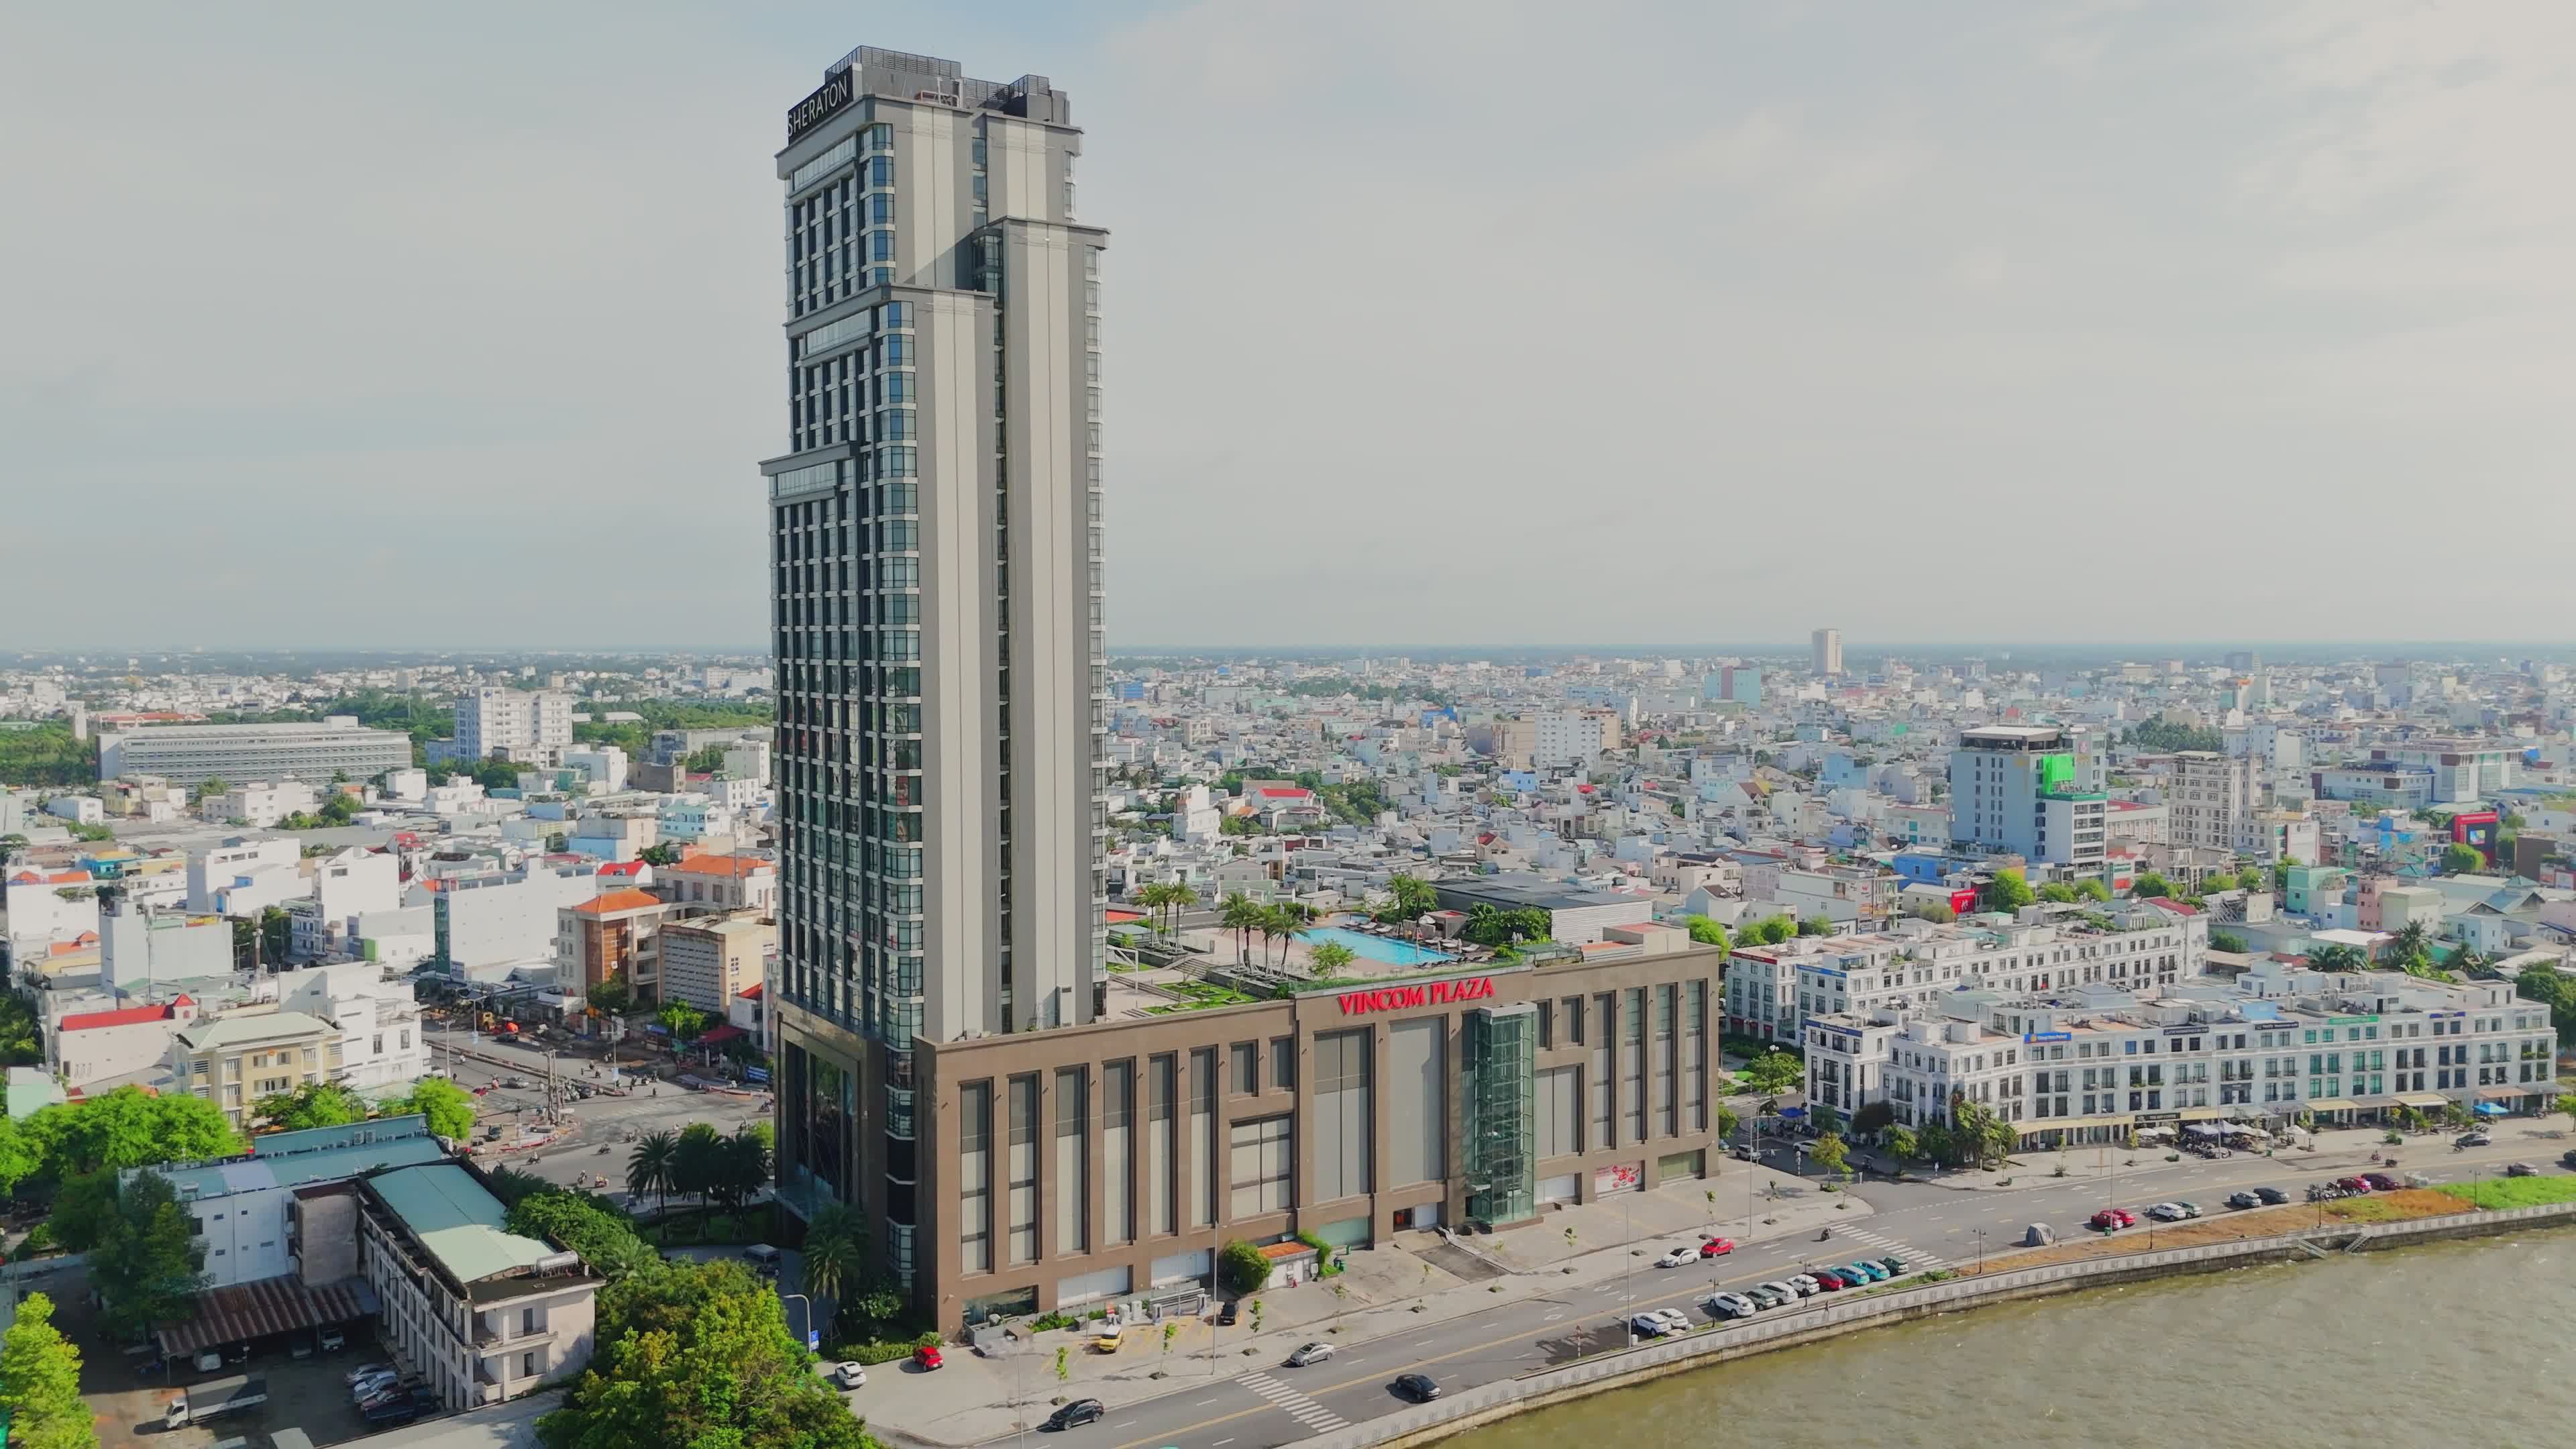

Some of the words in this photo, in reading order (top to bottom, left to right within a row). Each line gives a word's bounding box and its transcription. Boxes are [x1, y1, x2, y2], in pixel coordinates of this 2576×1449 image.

[788, 75, 847, 137] SHERATON
[1338, 985, 1426, 1015] VINCOM
[1430, 977, 1495, 1005] PLAZA
